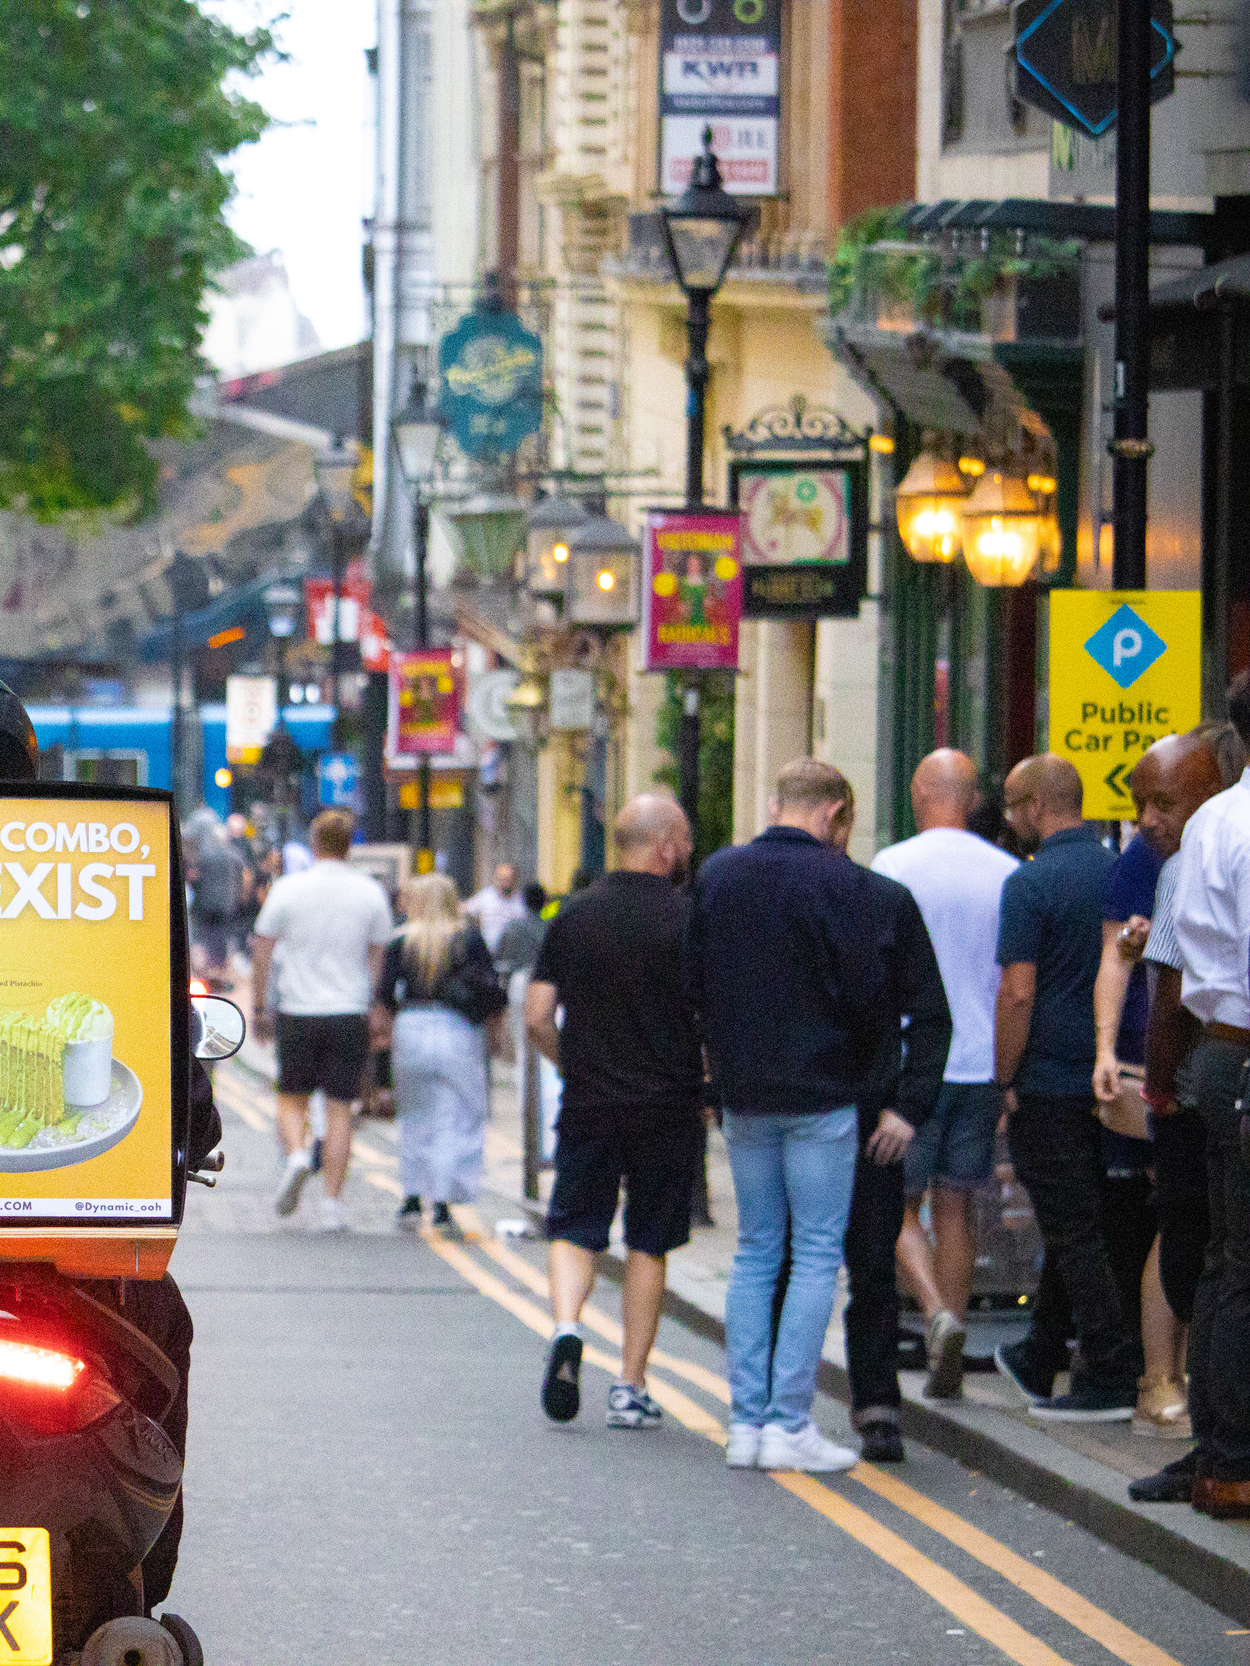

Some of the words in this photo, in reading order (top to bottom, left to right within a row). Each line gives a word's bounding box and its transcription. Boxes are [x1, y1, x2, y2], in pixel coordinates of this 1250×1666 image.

[1082, 702, 1169, 724] Public
[1065, 729, 1112, 752] Car
[1123, 730, 1176, 752] Pa
[0, 821, 150, 859] COMBO,
[75, 1201, 162, 1213] @Dynamic_ooh
